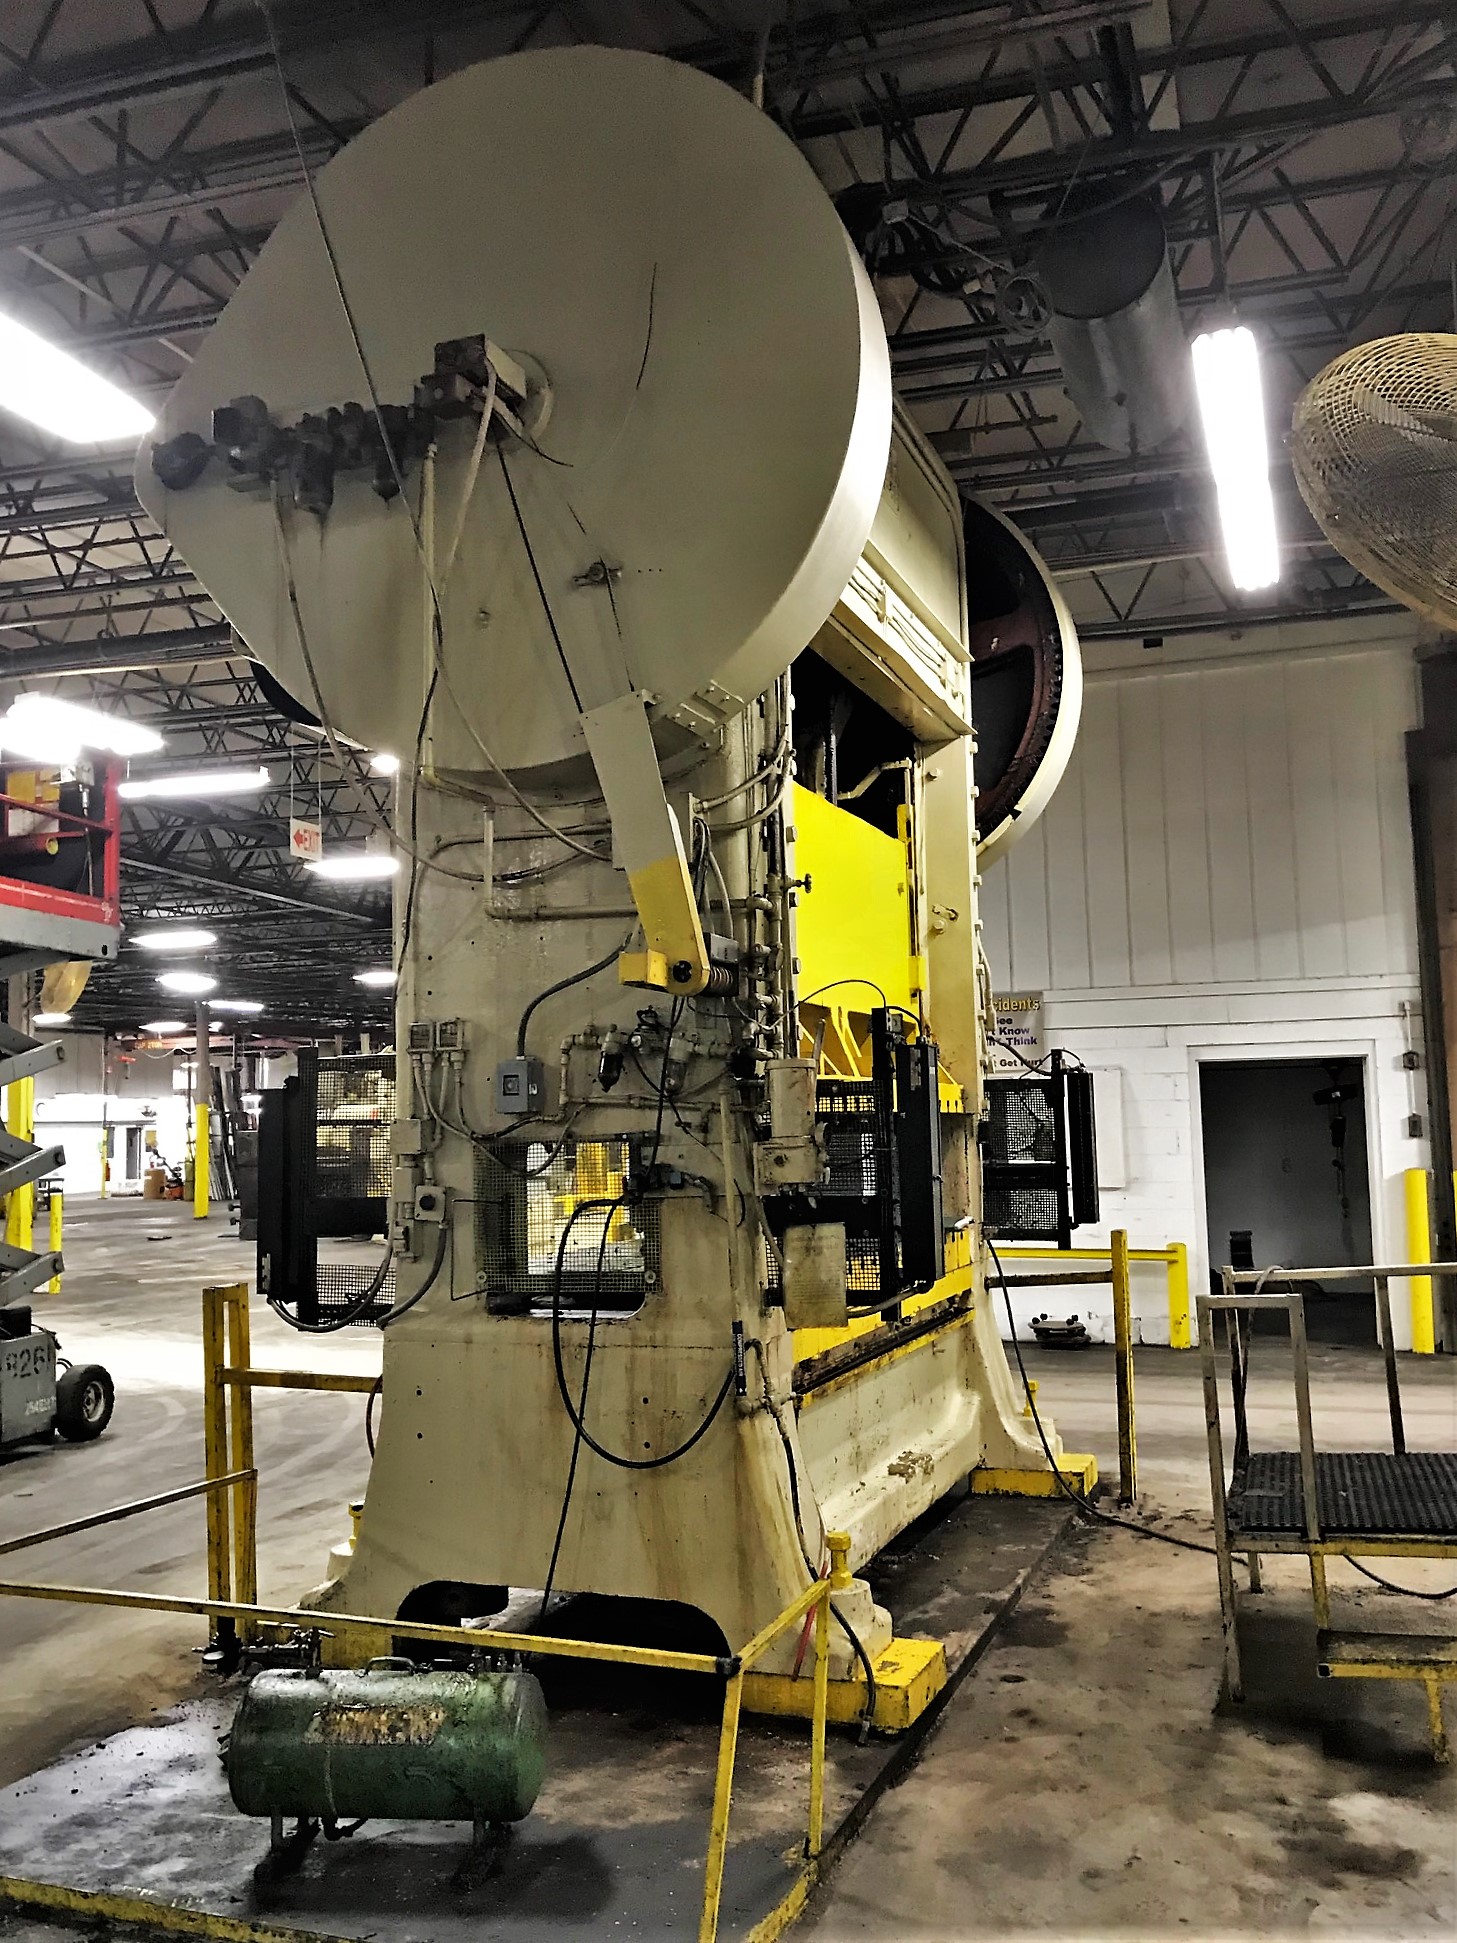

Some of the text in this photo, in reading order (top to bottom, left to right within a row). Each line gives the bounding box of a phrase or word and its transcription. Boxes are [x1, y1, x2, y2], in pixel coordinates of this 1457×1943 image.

[303, 829, 320, 852] EXIT
[992, 997, 1041, 1012] cidents
[999, 1027, 1030, 1035] Know
[1006, 1036, 1038, 1046] Think
[1000, 1059, 1017, 1067] Get
